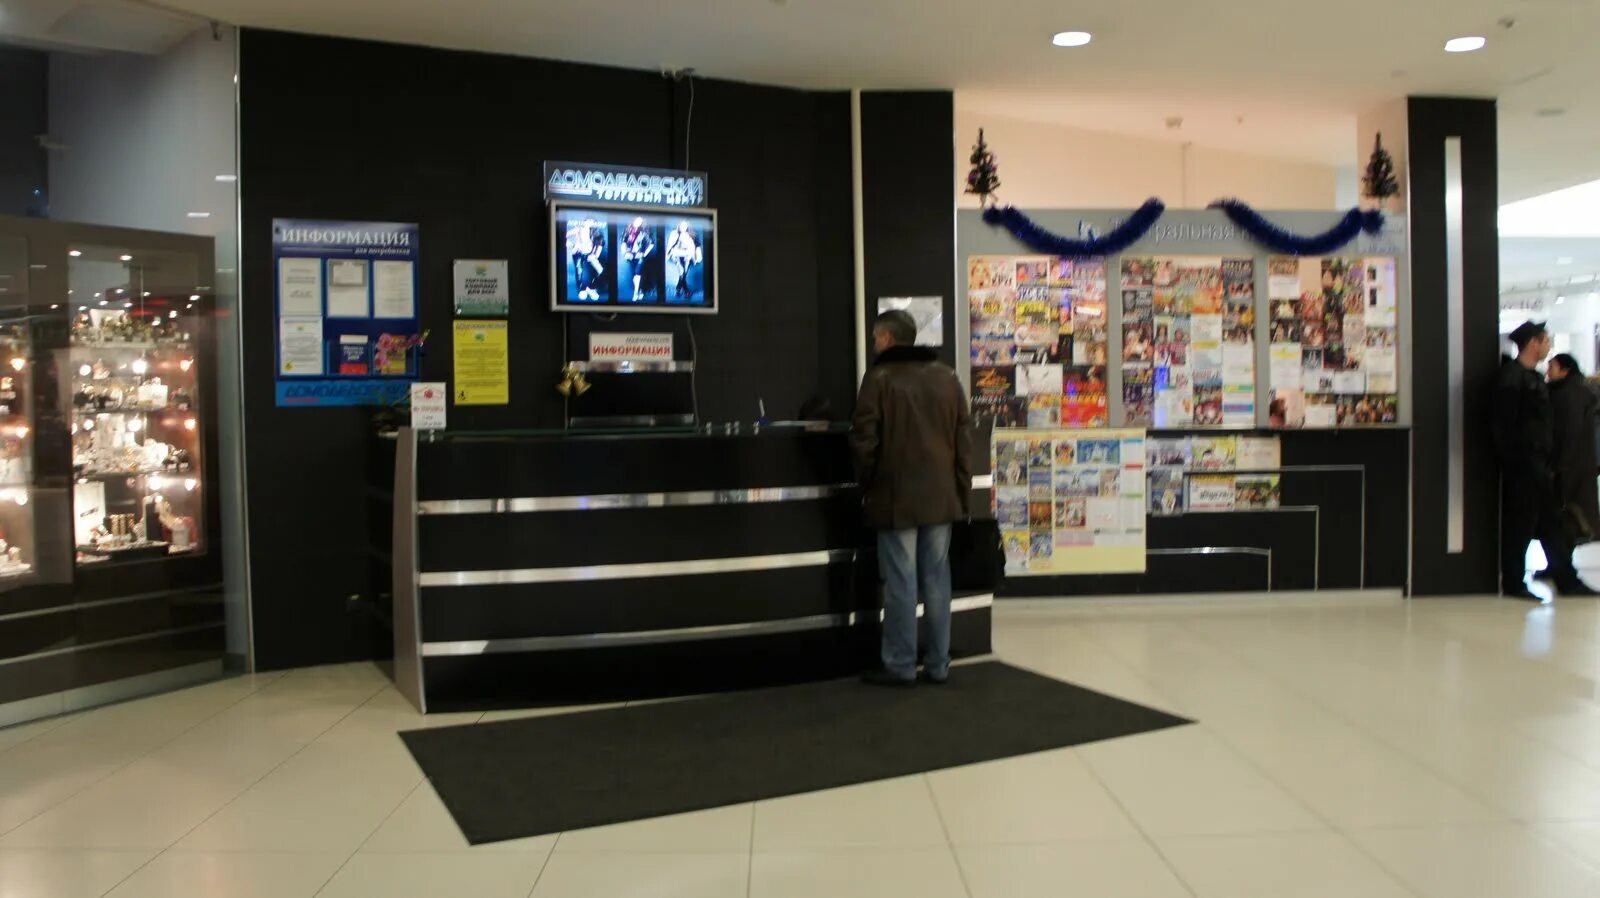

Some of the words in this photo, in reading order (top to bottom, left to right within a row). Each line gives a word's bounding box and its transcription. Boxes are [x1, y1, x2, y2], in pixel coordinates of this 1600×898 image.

[549, 168, 703, 197] ДОМОДЕДОВСКИЙ
[597, 187, 661, 203] ТОРГОВЫЙ
[282, 228, 410, 246] ИНФОРМАЦИЯ
[1109, 215, 1234, 245] Тральная
[592, 344, 671, 357] ИНФОРМАЦИЯ
